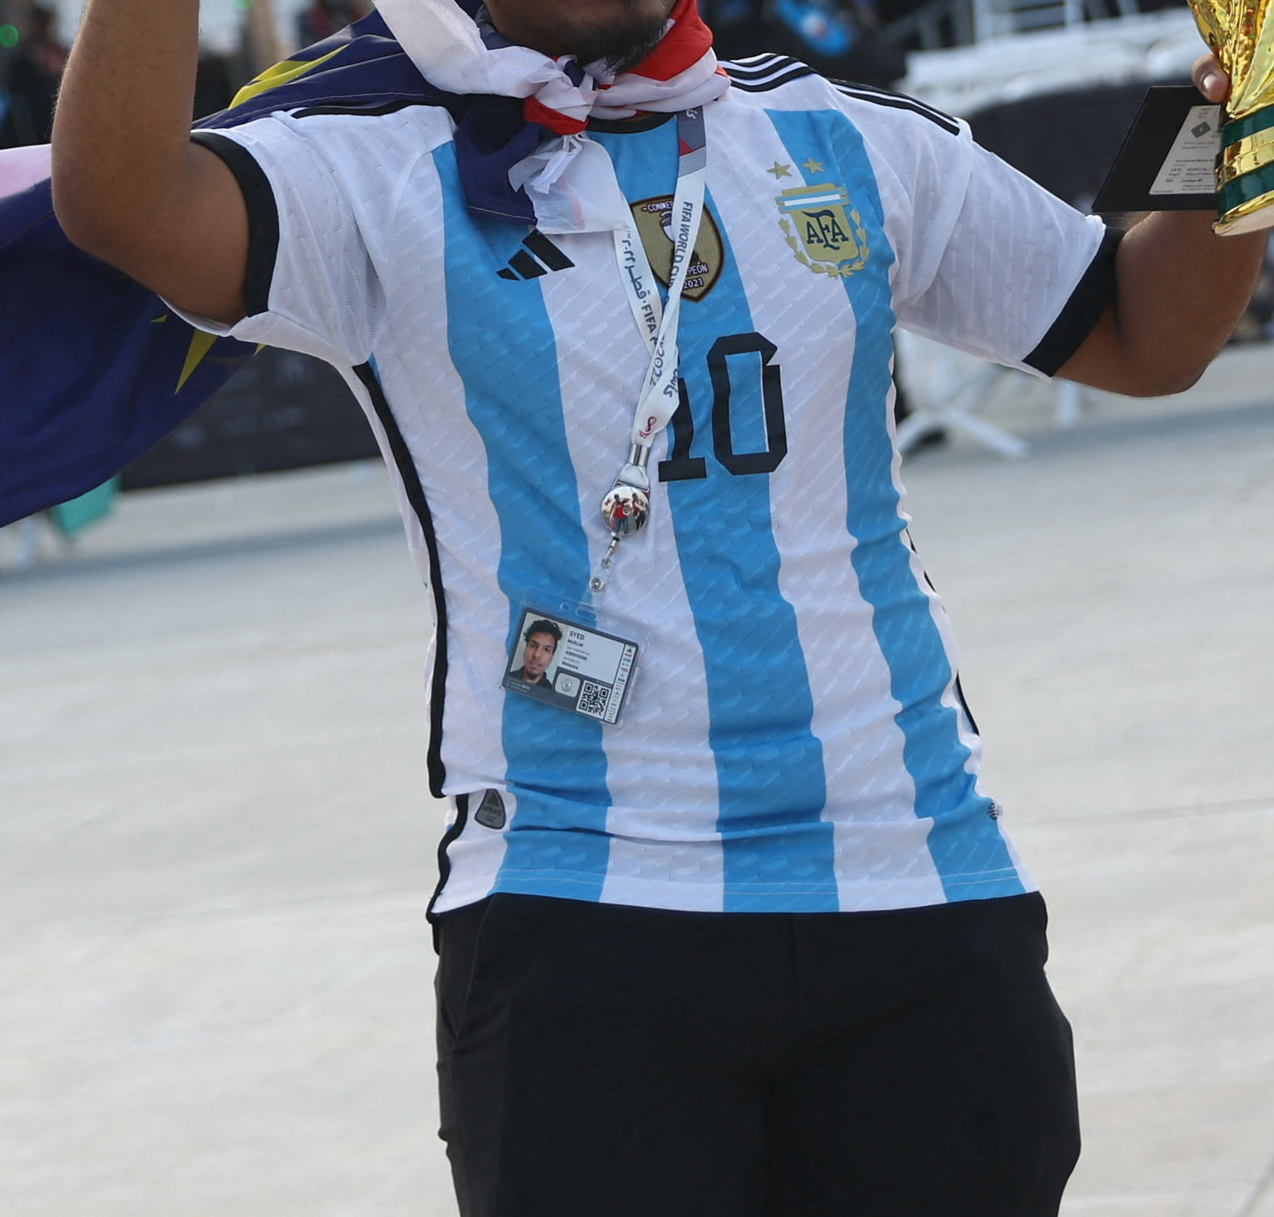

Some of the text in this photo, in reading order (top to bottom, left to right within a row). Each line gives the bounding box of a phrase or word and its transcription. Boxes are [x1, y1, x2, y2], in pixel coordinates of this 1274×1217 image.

[648, 201, 673, 212] CONME
[681, 201, 693, 222] FIFA
[673, 223, 690, 263] WORLD
[801, 209, 849, 251] AFA
[624, 265, 651, 300] قطر
[641, 303, 658, 334] FIFA
[657, 331, 788, 483] 10
[569, 630, 585, 641] SYED
